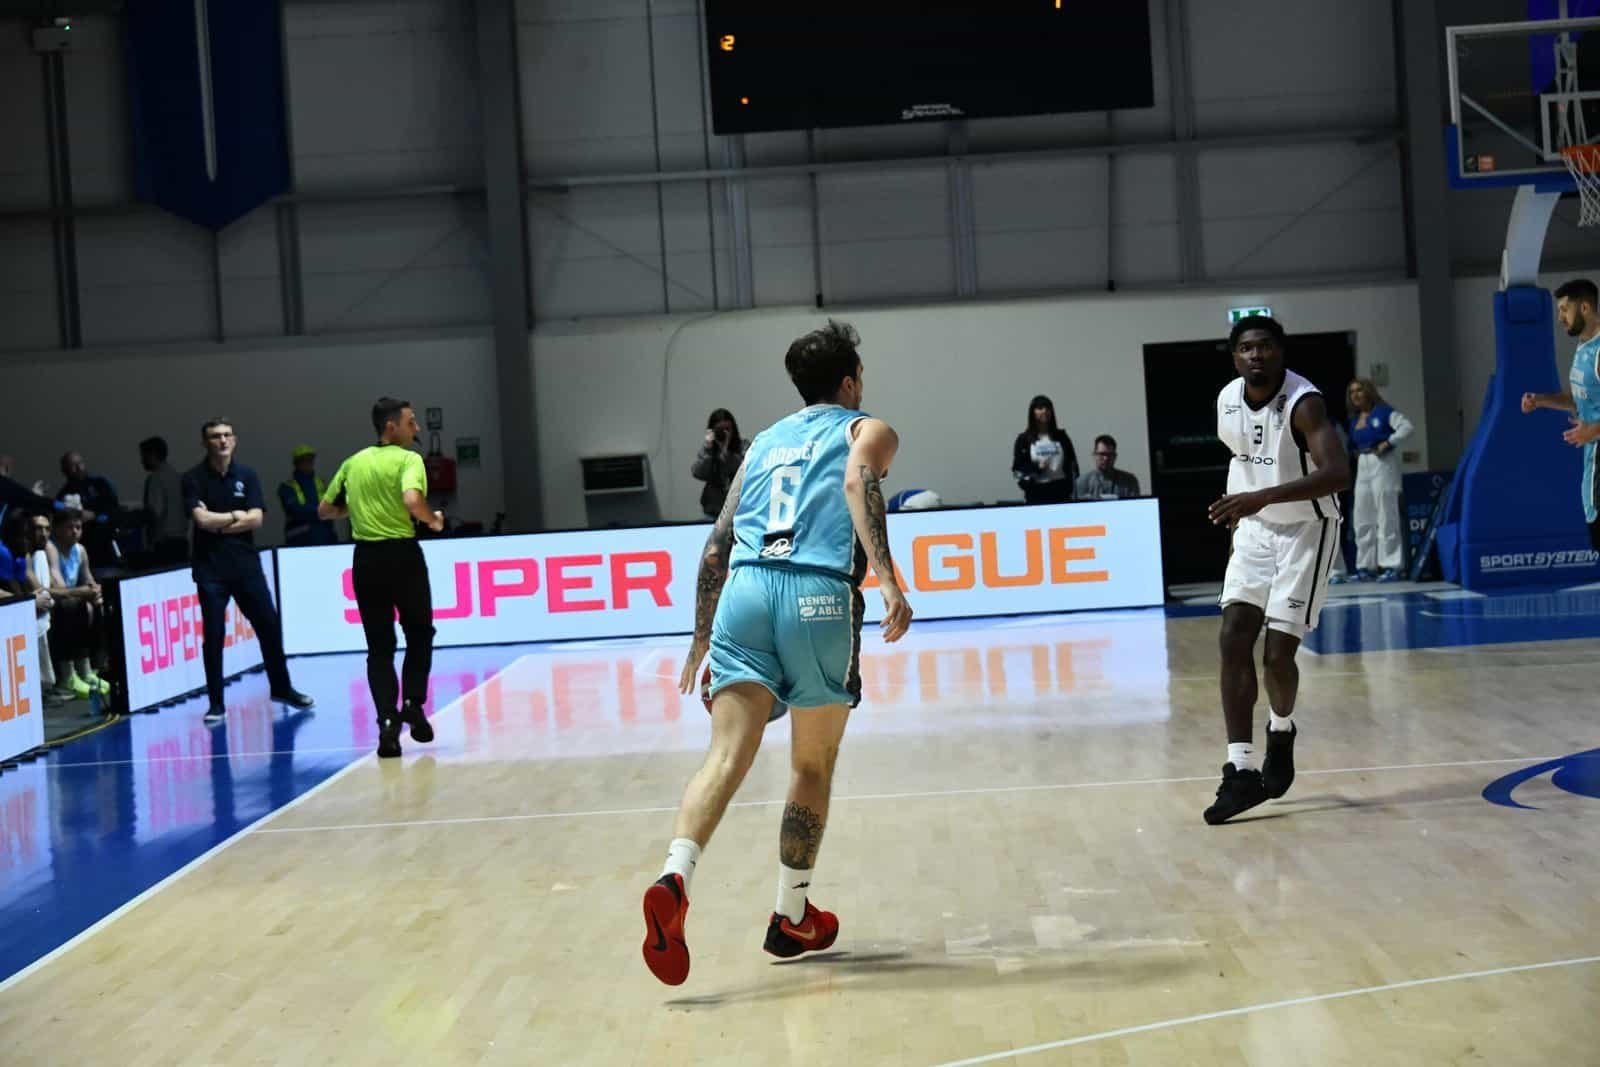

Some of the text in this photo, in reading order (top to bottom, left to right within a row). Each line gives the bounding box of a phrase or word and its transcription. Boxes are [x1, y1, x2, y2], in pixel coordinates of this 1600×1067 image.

[1253, 425, 1264, 445] 3
[767, 465, 801, 534] 6
[818, 605, 844, 616] ABLE
